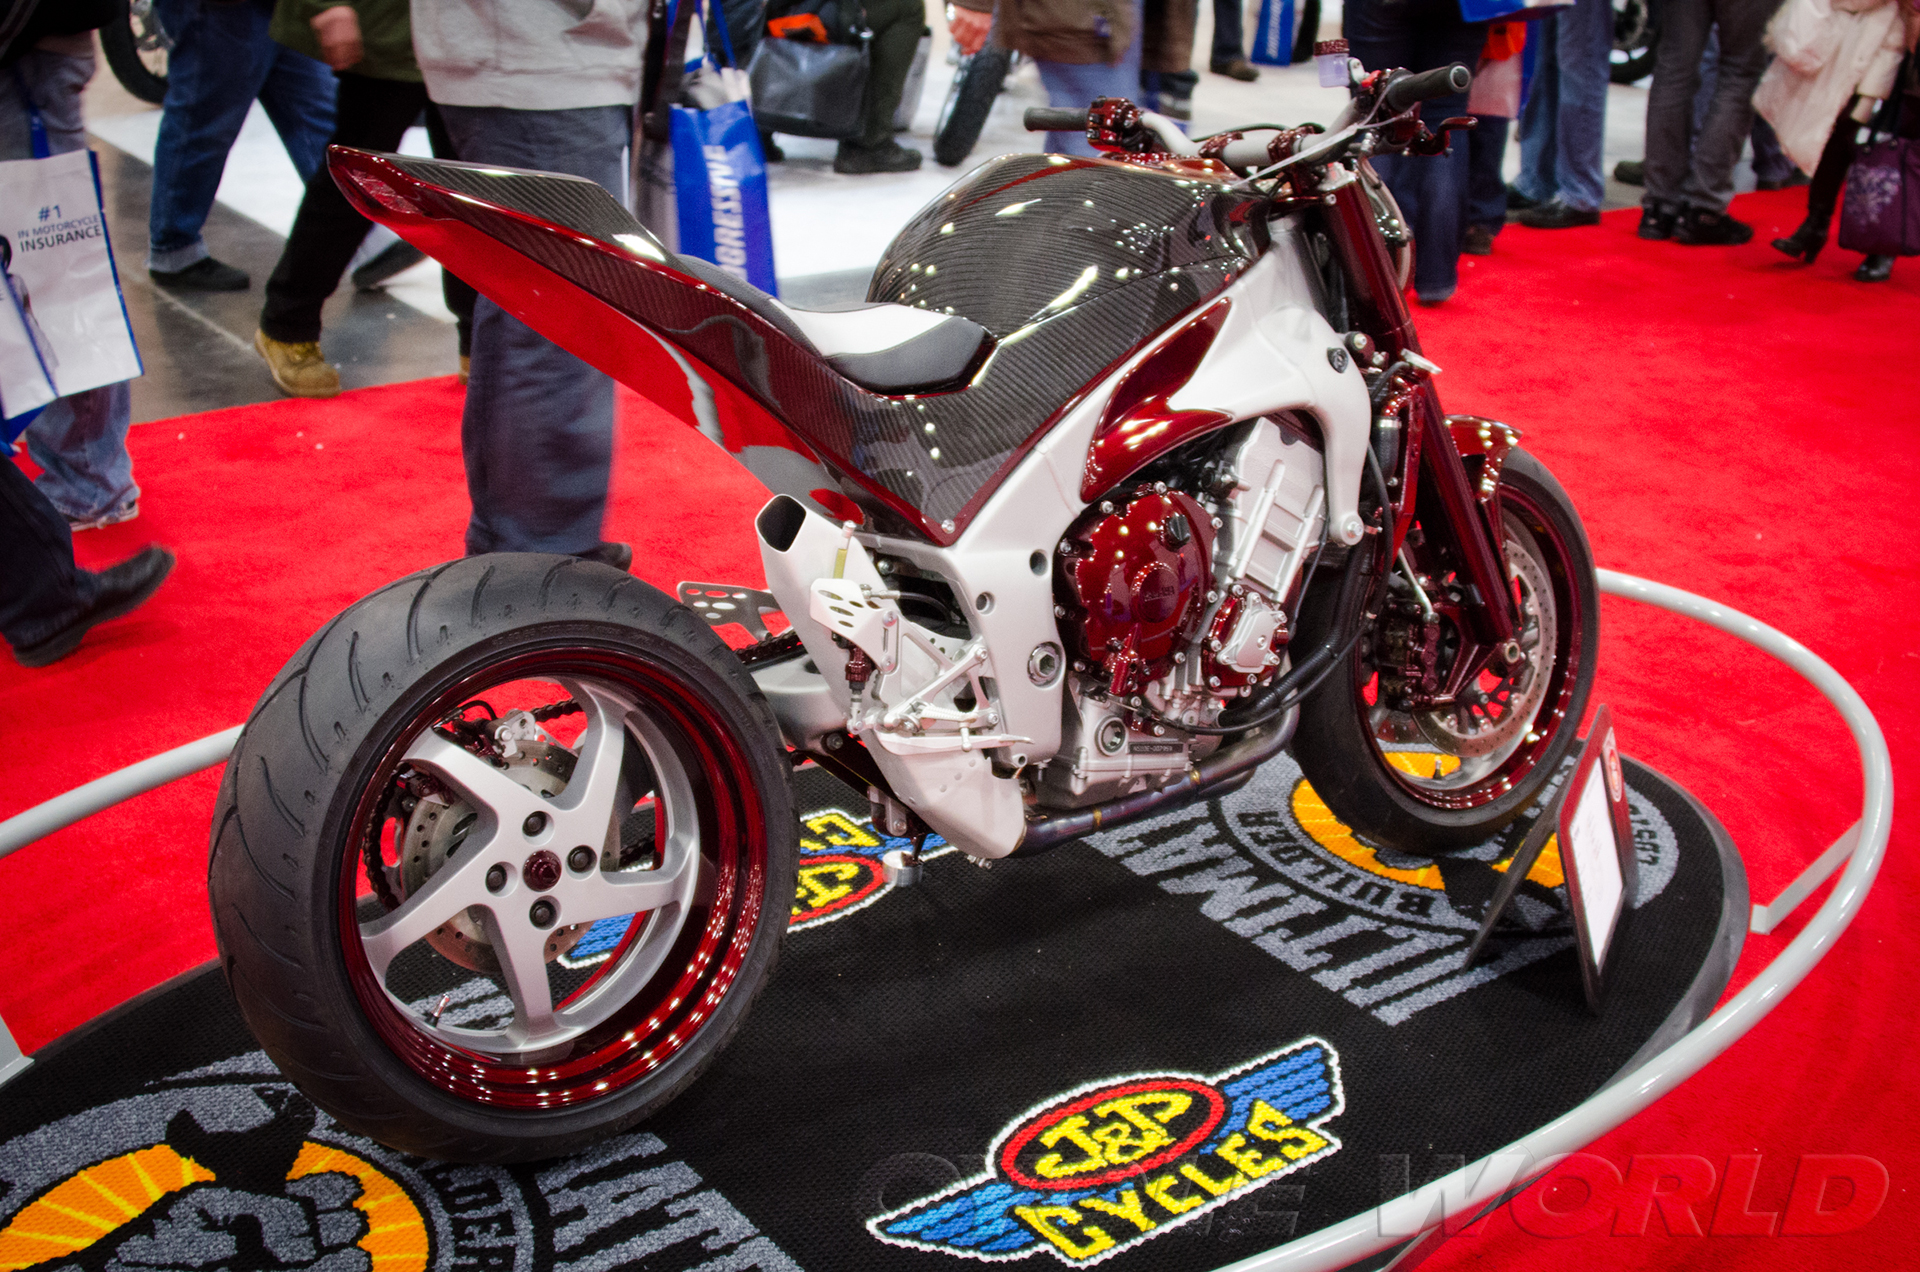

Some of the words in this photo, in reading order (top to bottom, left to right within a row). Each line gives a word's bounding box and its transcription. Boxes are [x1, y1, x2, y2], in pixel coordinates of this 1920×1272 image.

[18, 230, 29, 239] IN
[33, 215, 98, 236] MOTORCYCLE
[20, 225, 101, 252] INSURANCE
[39, 205, 62, 221] #1
[1237, 809, 1434, 918] BUILDER
[1035, 1091, 1193, 1178] J&P
[1014, 1099, 1328, 1261] CYCLES
